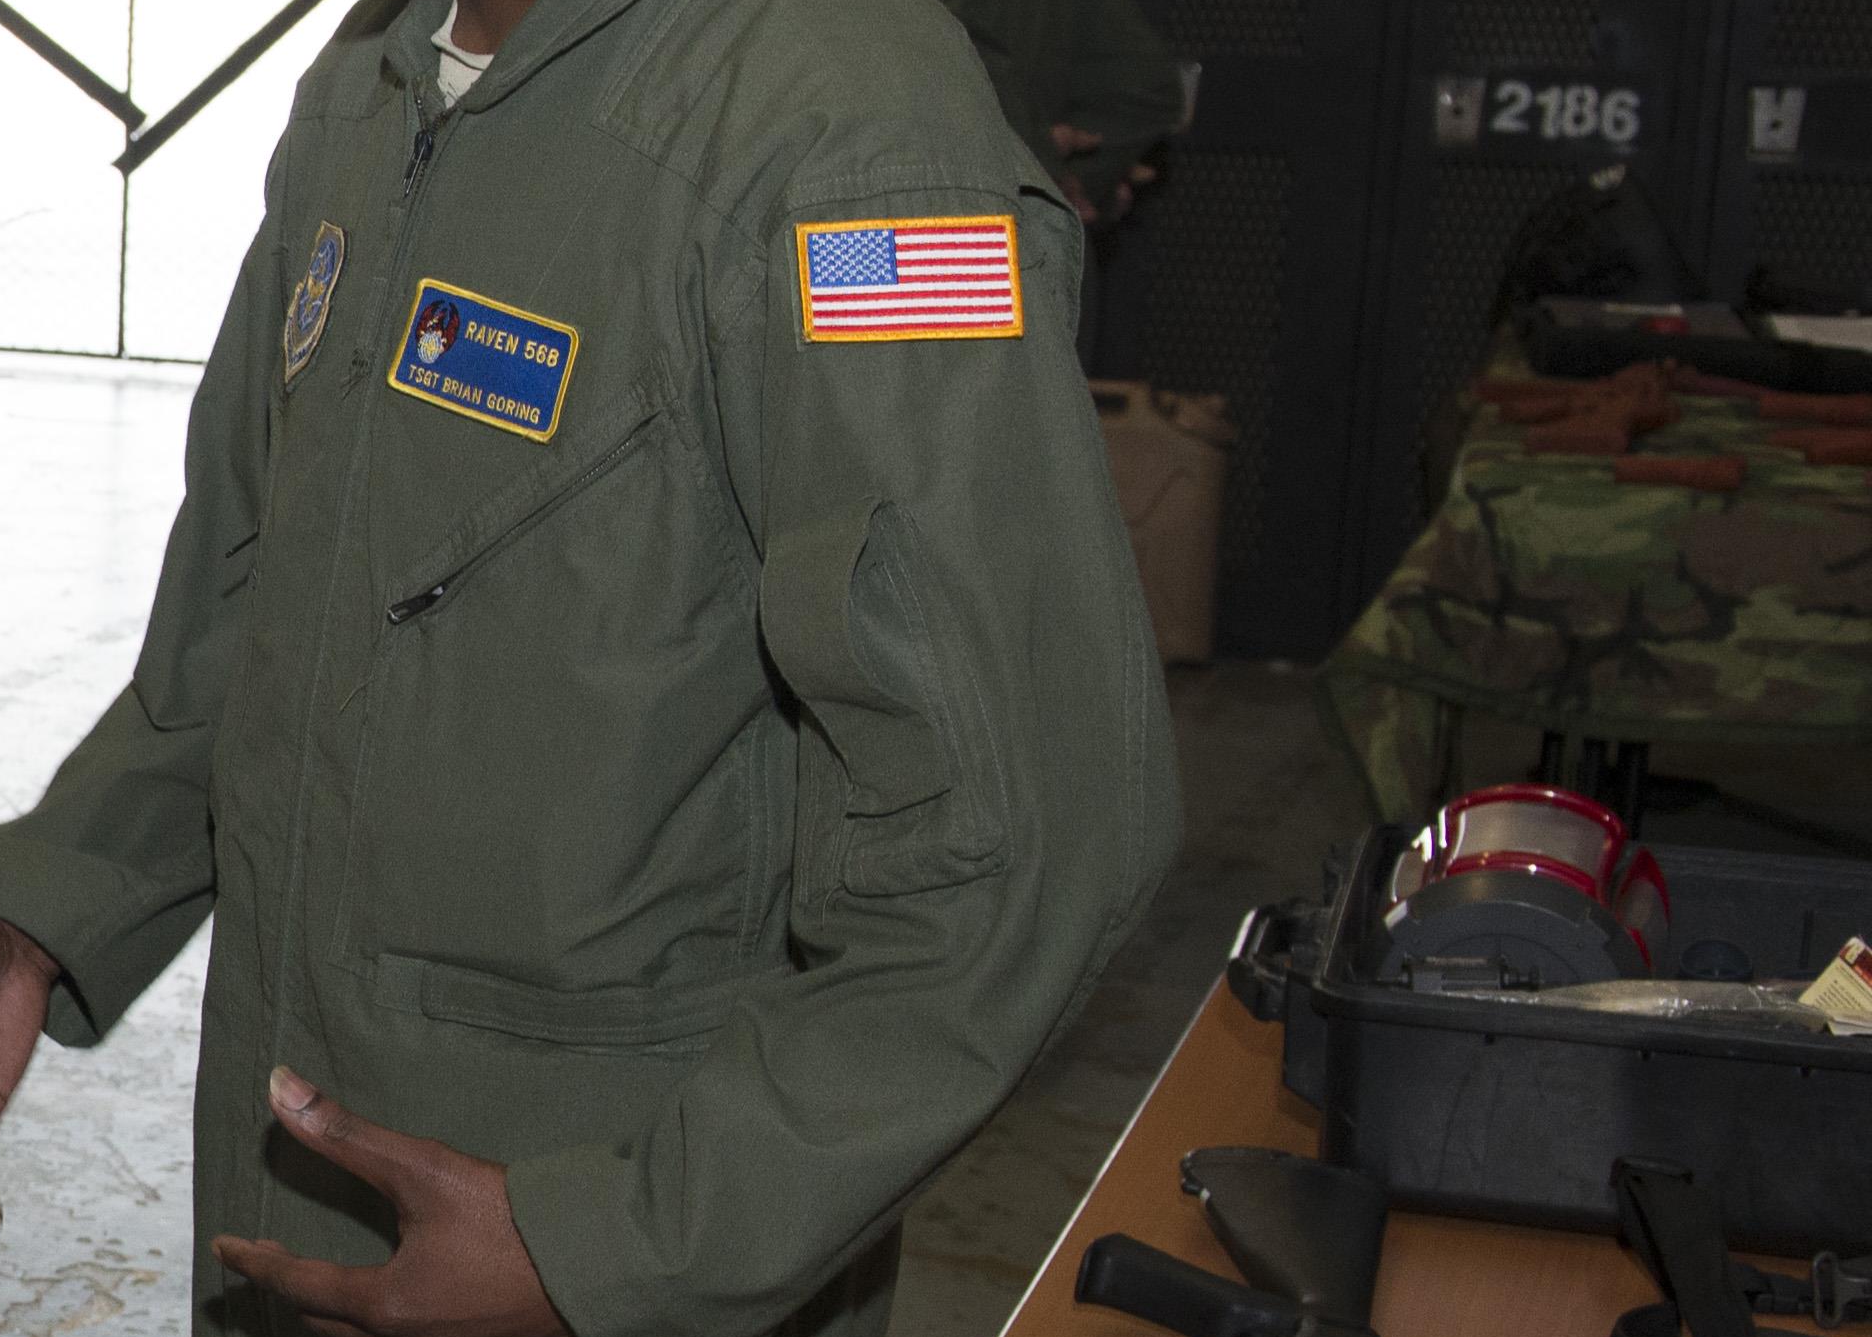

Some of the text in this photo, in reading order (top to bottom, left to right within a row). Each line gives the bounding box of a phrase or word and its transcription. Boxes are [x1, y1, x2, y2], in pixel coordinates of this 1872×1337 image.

[1493, 79, 1641, 143] 2186
[465, 321, 520, 355] RAVEN
[408, 364, 541, 425] TSGT BRIAN GORING
